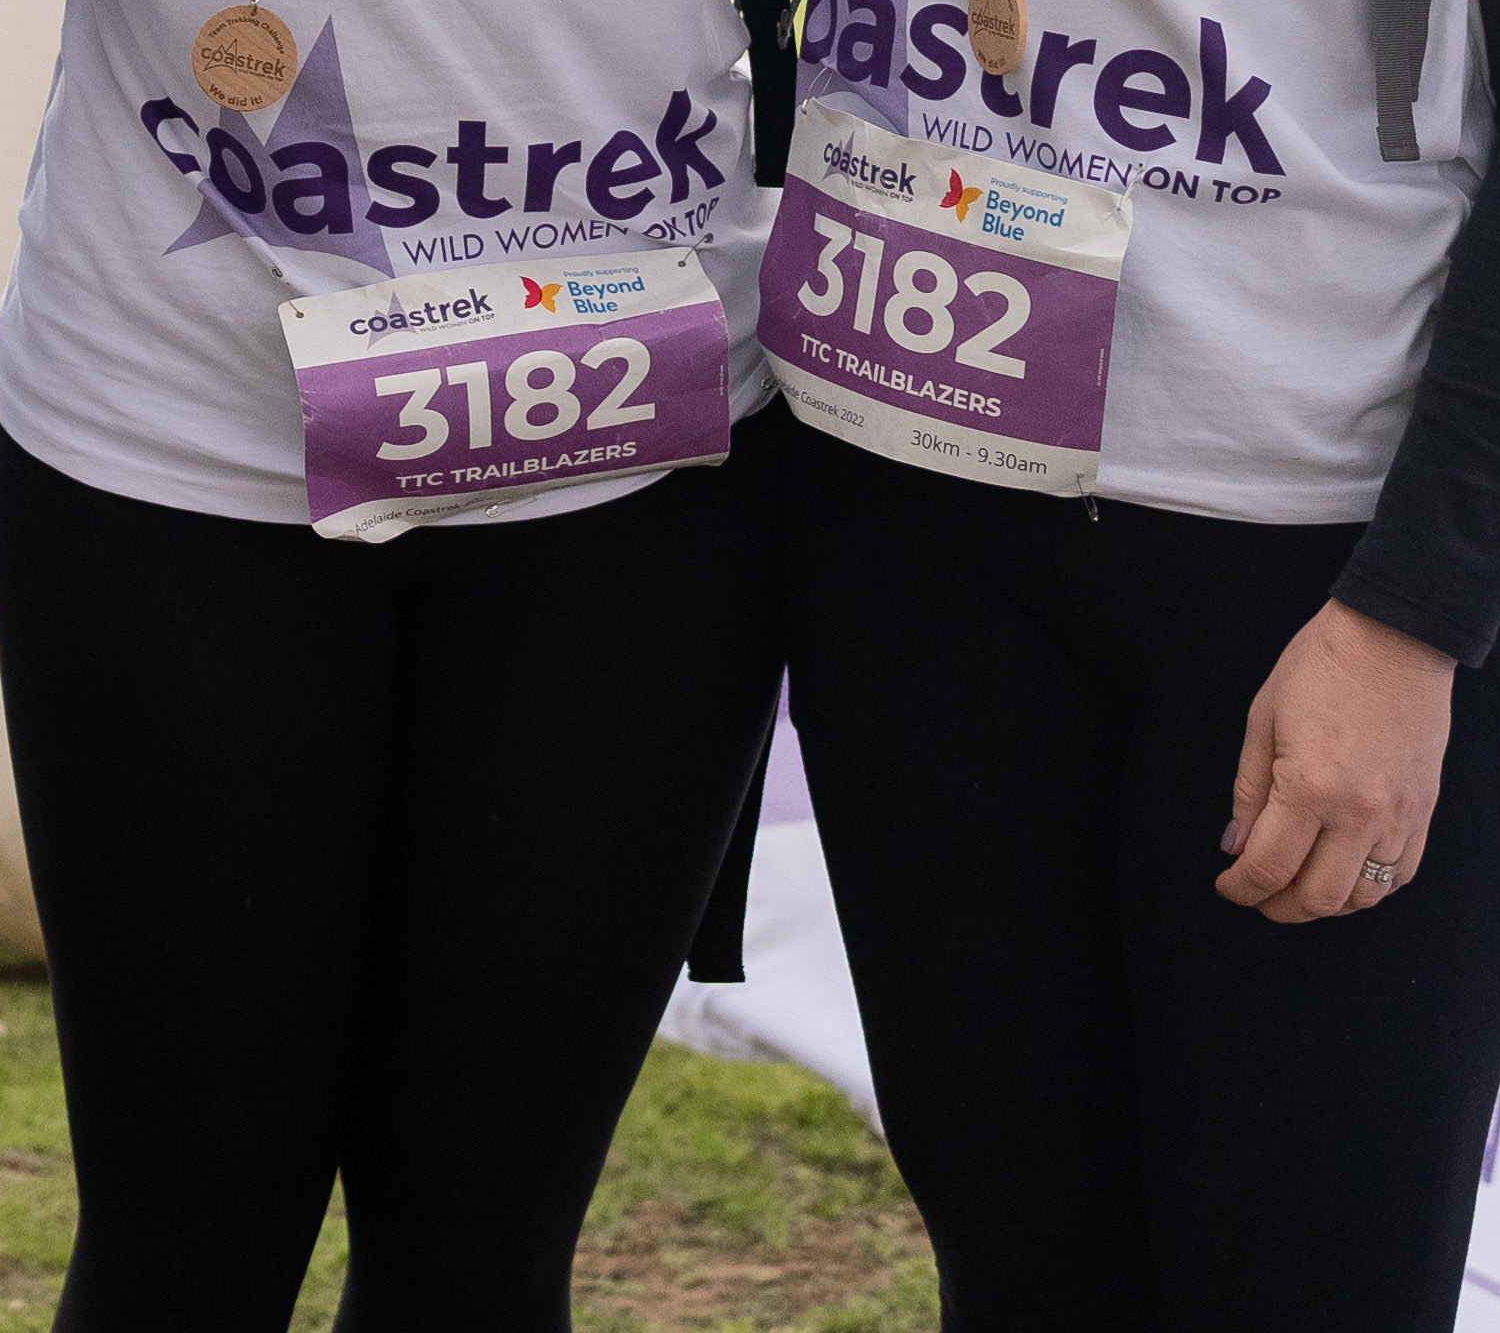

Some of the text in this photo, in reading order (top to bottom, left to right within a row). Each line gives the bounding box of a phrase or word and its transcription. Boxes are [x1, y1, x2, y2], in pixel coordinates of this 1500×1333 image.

[208, 23, 227, 38] Team
[227, 16, 260, 26] Trekking
[201, 47, 287, 77] coastrek
[209, 84, 247, 106] We did
[140, 88, 726, 234] coastrek
[823, 141, 916, 195] coastrek
[921, 113, 1281, 204] WILD WOMEN ON TOP
[901, 194, 913, 203] TOP
[987, 190, 1064, 228] Beyond
[990, 177, 1068, 205] Proudly supporting
[402, 235, 484, 266] WILD
[495, 220, 628, 254] WOMEN
[685, 197, 719, 235] TOP
[982, 216, 1025, 241] Blue
[563, 266, 638, 278] Proudly supporting
[568, 276, 645, 299] Beyond
[350, 289, 493, 335] coastrek
[574, 297, 618, 314] Blue
[797, 212, 1031, 380] 3182
[419, 313, 495, 333] WILD WOMEN ON TOP
[801, 333, 1002, 418] TTC TRAILBLAZERS
[375, 337, 656, 460] 3182
[801, 391, 864, 428] Coastrek 2022
[396, 441, 638, 489] TTC TRAILBLAZERS
[911, 430, 1048, 475] 30km 9.30am
[354, 503, 460, 535] Adelaide Coastrek
